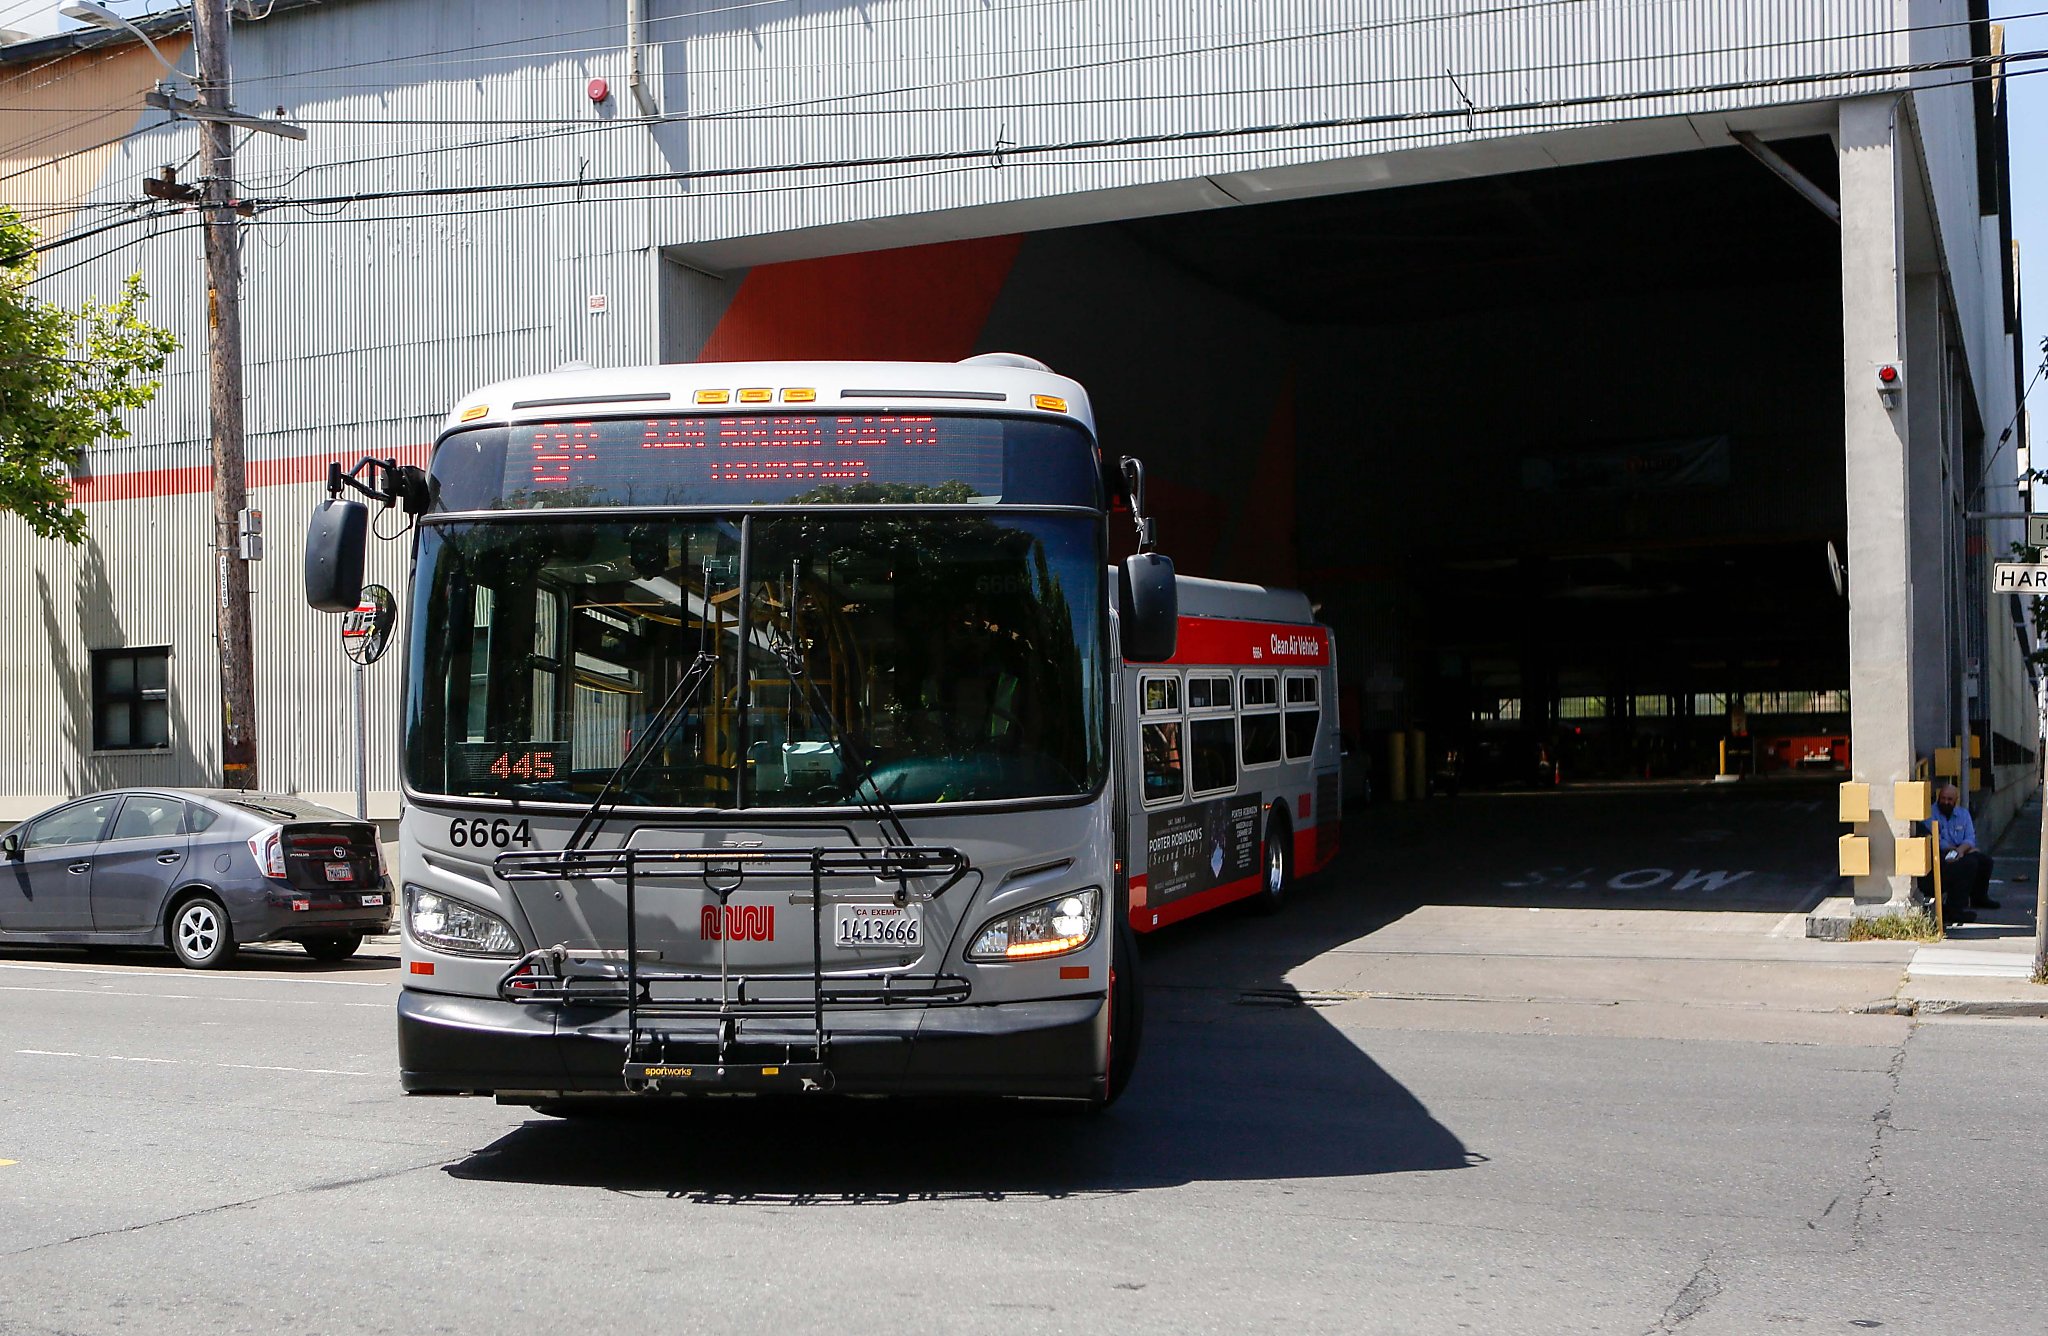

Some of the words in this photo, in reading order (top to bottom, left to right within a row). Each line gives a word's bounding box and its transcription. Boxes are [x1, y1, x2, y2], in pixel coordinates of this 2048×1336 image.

[1271, 634, 1288, 655] Clean
[1289, 634, 1298, 655] Air
[1298, 636, 1318, 655] Vehicle
[491, 752, 555, 779] 445
[449, 817, 532, 848] 6664
[1149, 835, 1171, 853] PORTER
[856, 908, 868, 916] CA
[871, 908, 902, 916] EXEMPT
[840, 918, 919, 941] 1413666
[645, 1066, 692, 1077] sportworks
